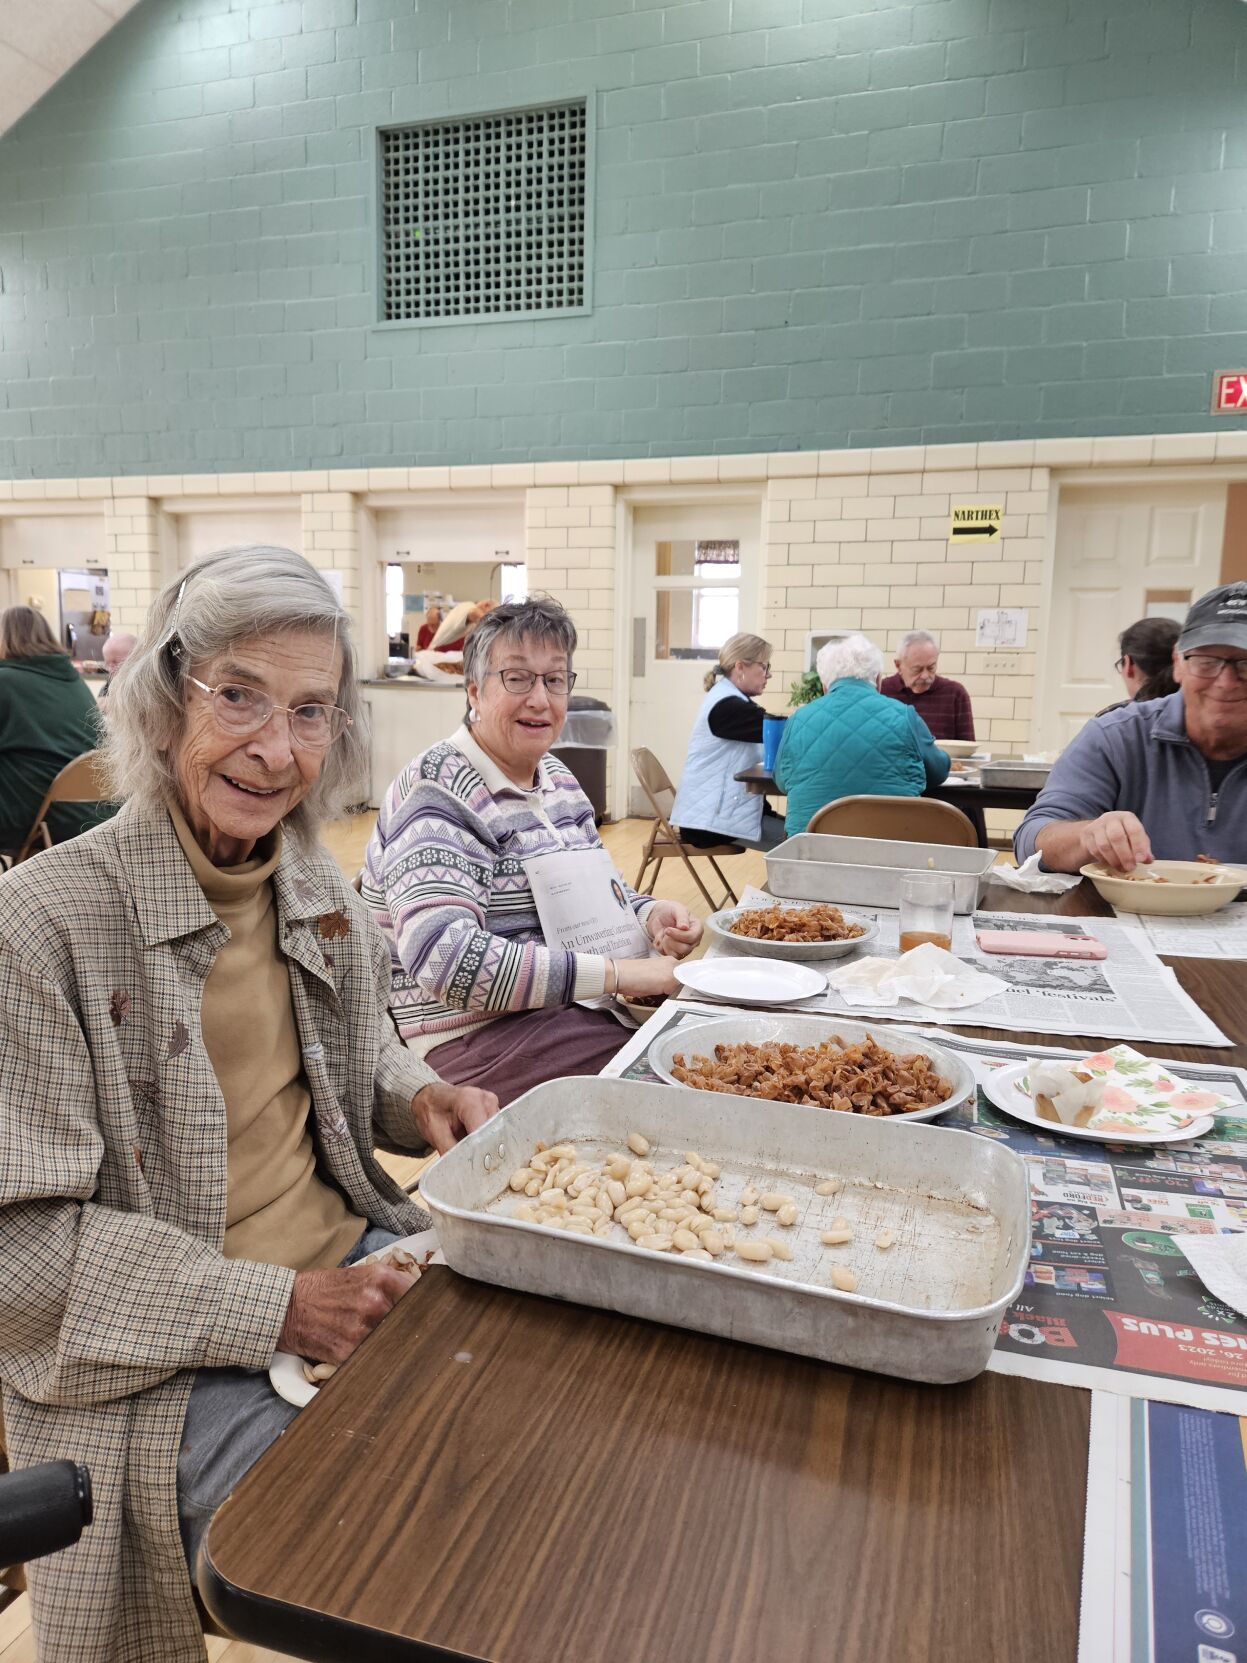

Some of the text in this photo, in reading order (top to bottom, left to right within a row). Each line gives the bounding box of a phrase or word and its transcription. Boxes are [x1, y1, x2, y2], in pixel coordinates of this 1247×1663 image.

[953, 509, 1001, 521] NARTHEX
[560, 939, 575, 950] An
[1016, 1304, 1034, 1312] All
[1121, 1317, 1194, 1342] PLUS
[1178, 1344, 1216, 1356] 2023
